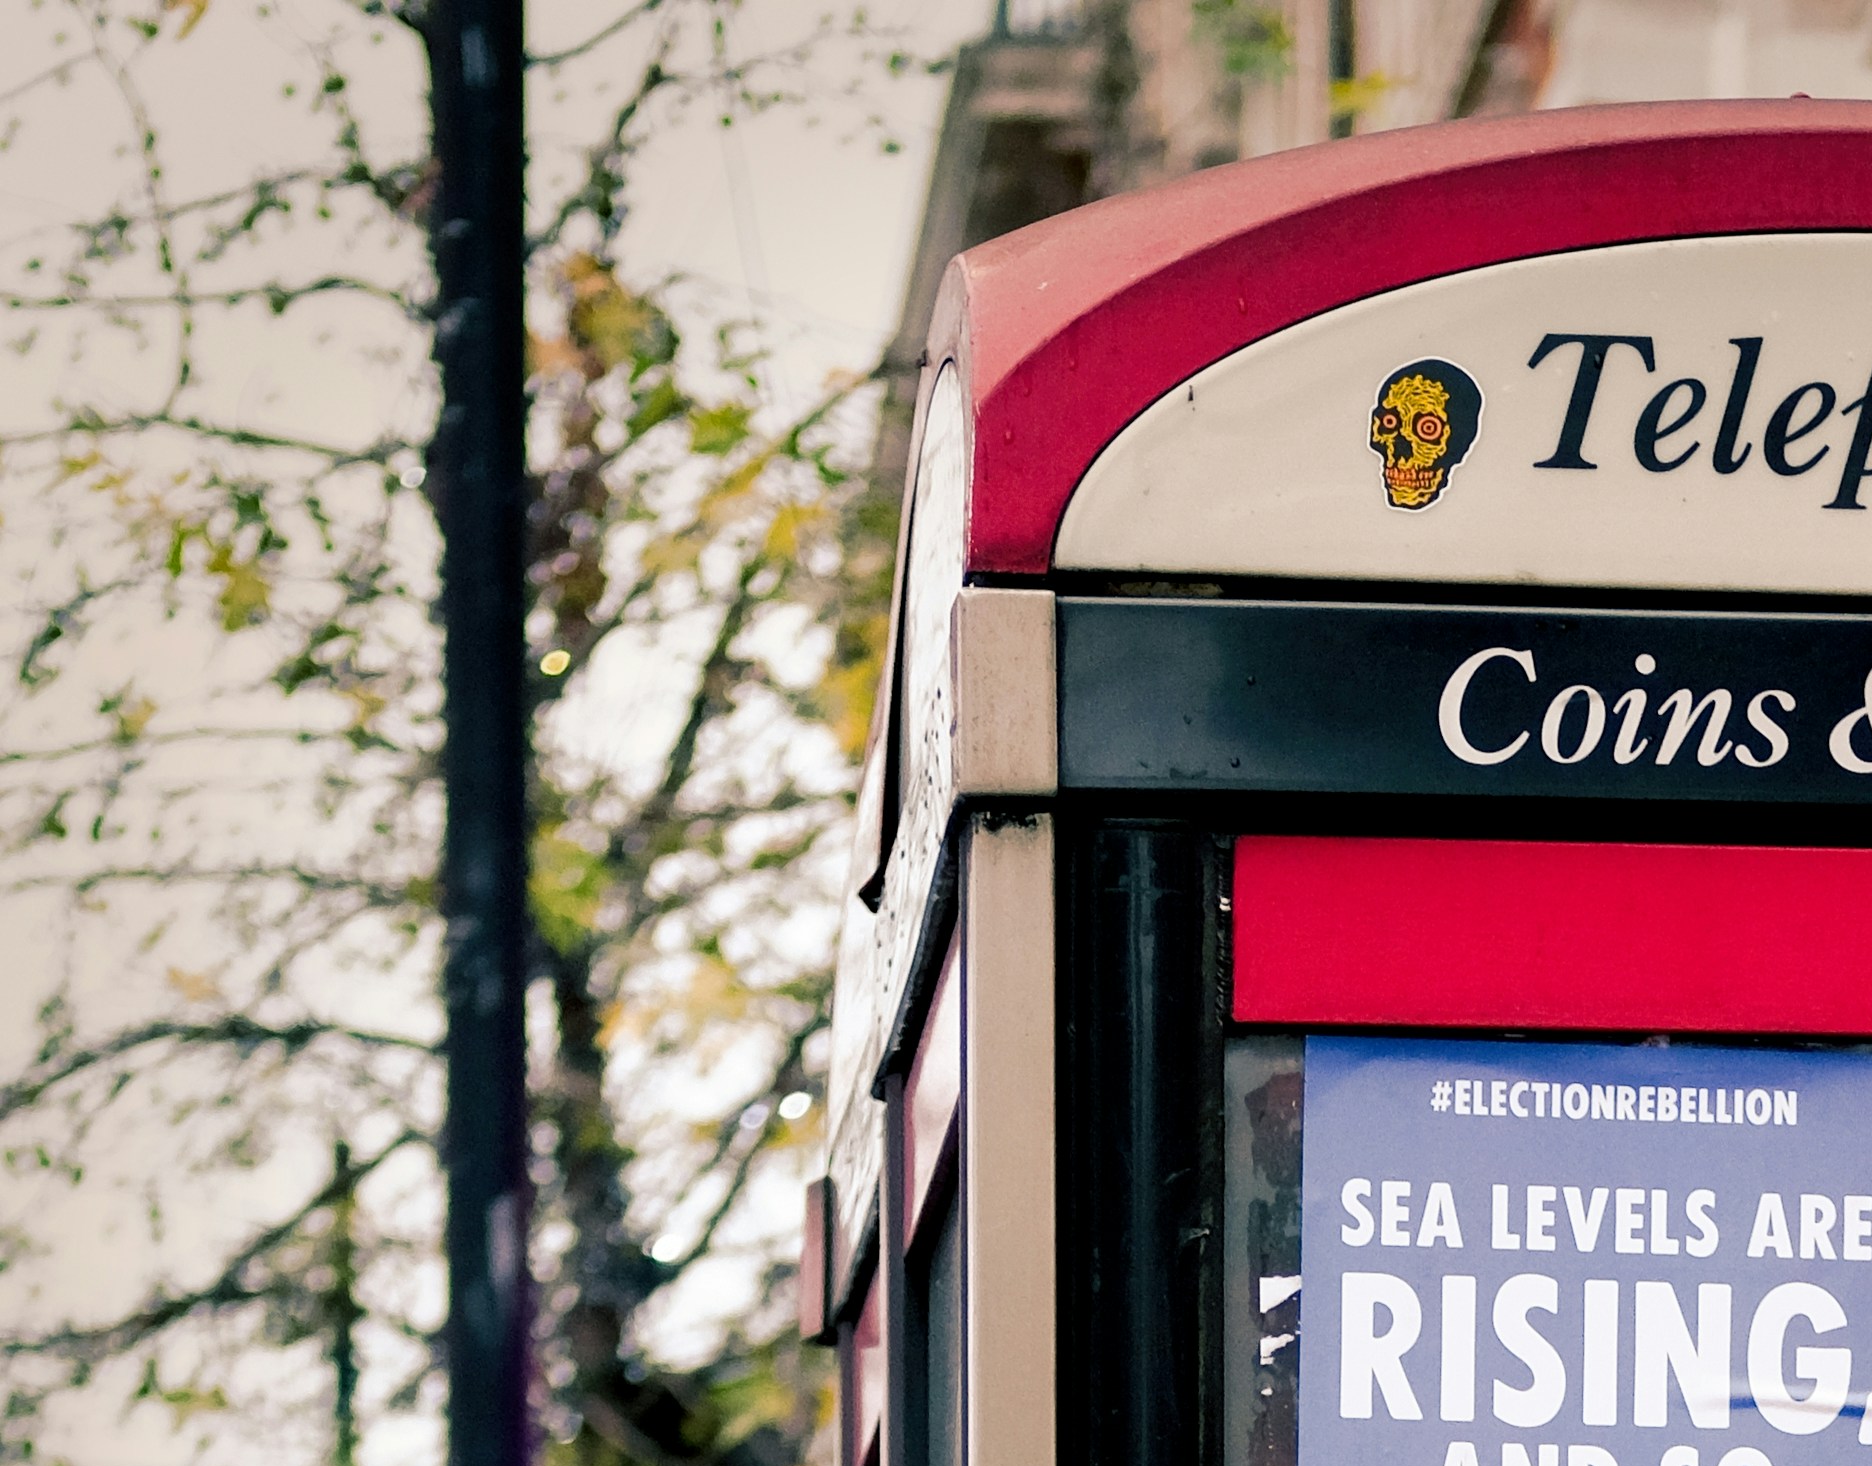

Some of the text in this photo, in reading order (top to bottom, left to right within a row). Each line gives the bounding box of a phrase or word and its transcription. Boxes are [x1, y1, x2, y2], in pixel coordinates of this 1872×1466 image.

[1437, 646, 1798, 771] Coins
[1430, 1079, 1798, 1126] #ELECTIONREBELLION
[1340, 1177, 1464, 1249] SEA
[1491, 1184, 1720, 1259] LEVELS
